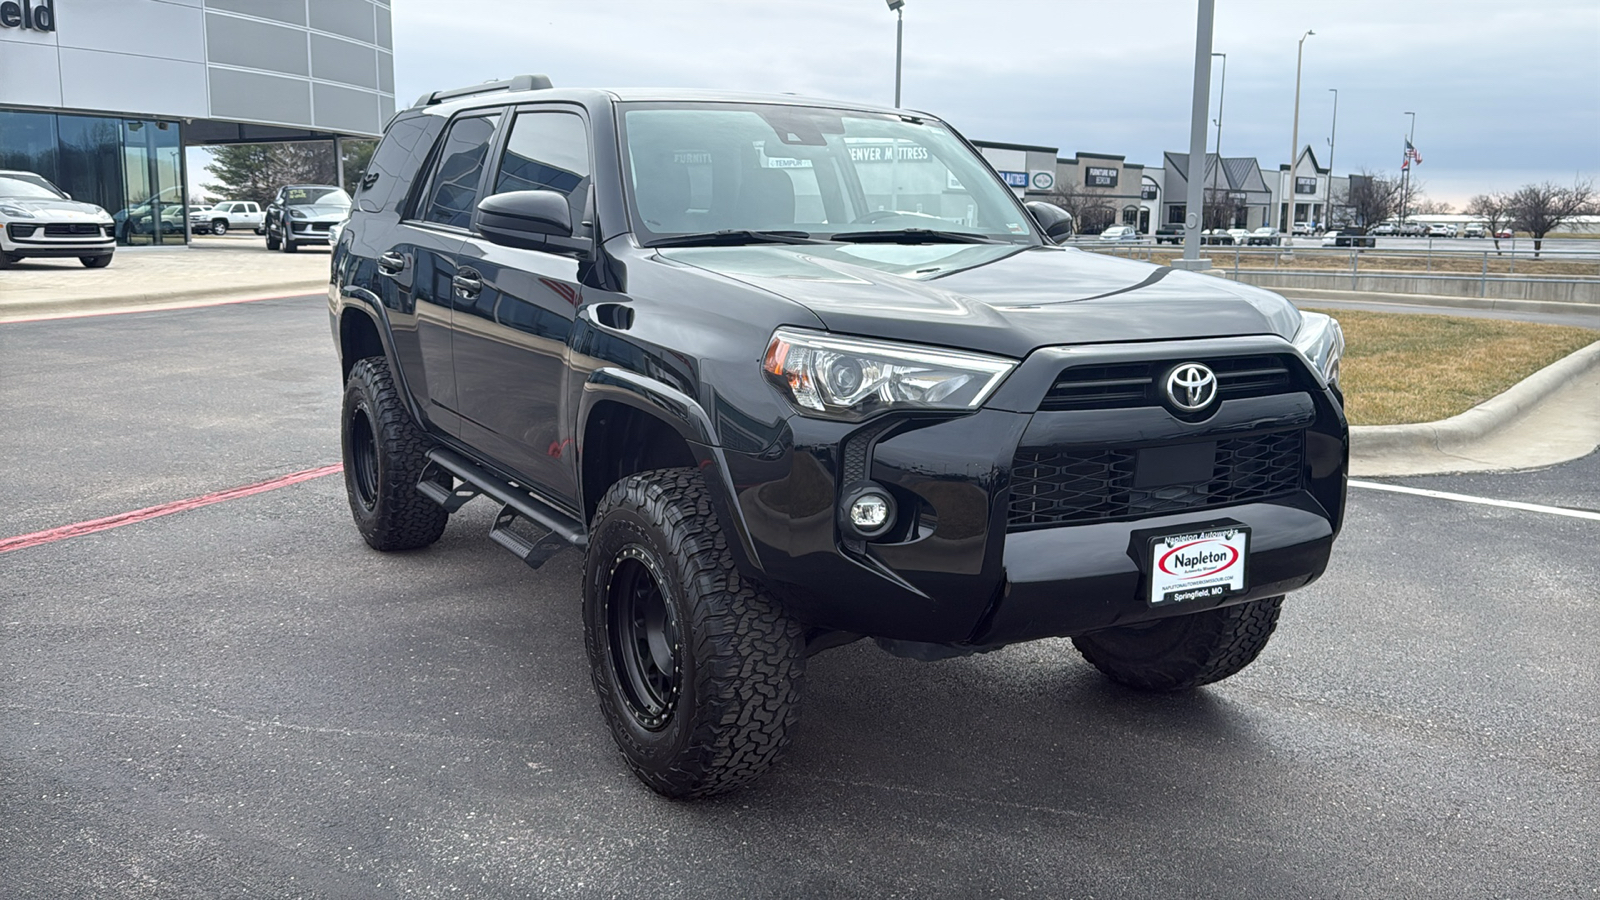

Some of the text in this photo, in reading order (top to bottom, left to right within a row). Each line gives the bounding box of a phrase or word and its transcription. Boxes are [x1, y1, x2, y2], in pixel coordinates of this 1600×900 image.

[884, 147, 928, 160] MTTRESS
[1174, 551, 1227, 569] Napleton
[1174, 586, 1223, 602] Springfield, MO
